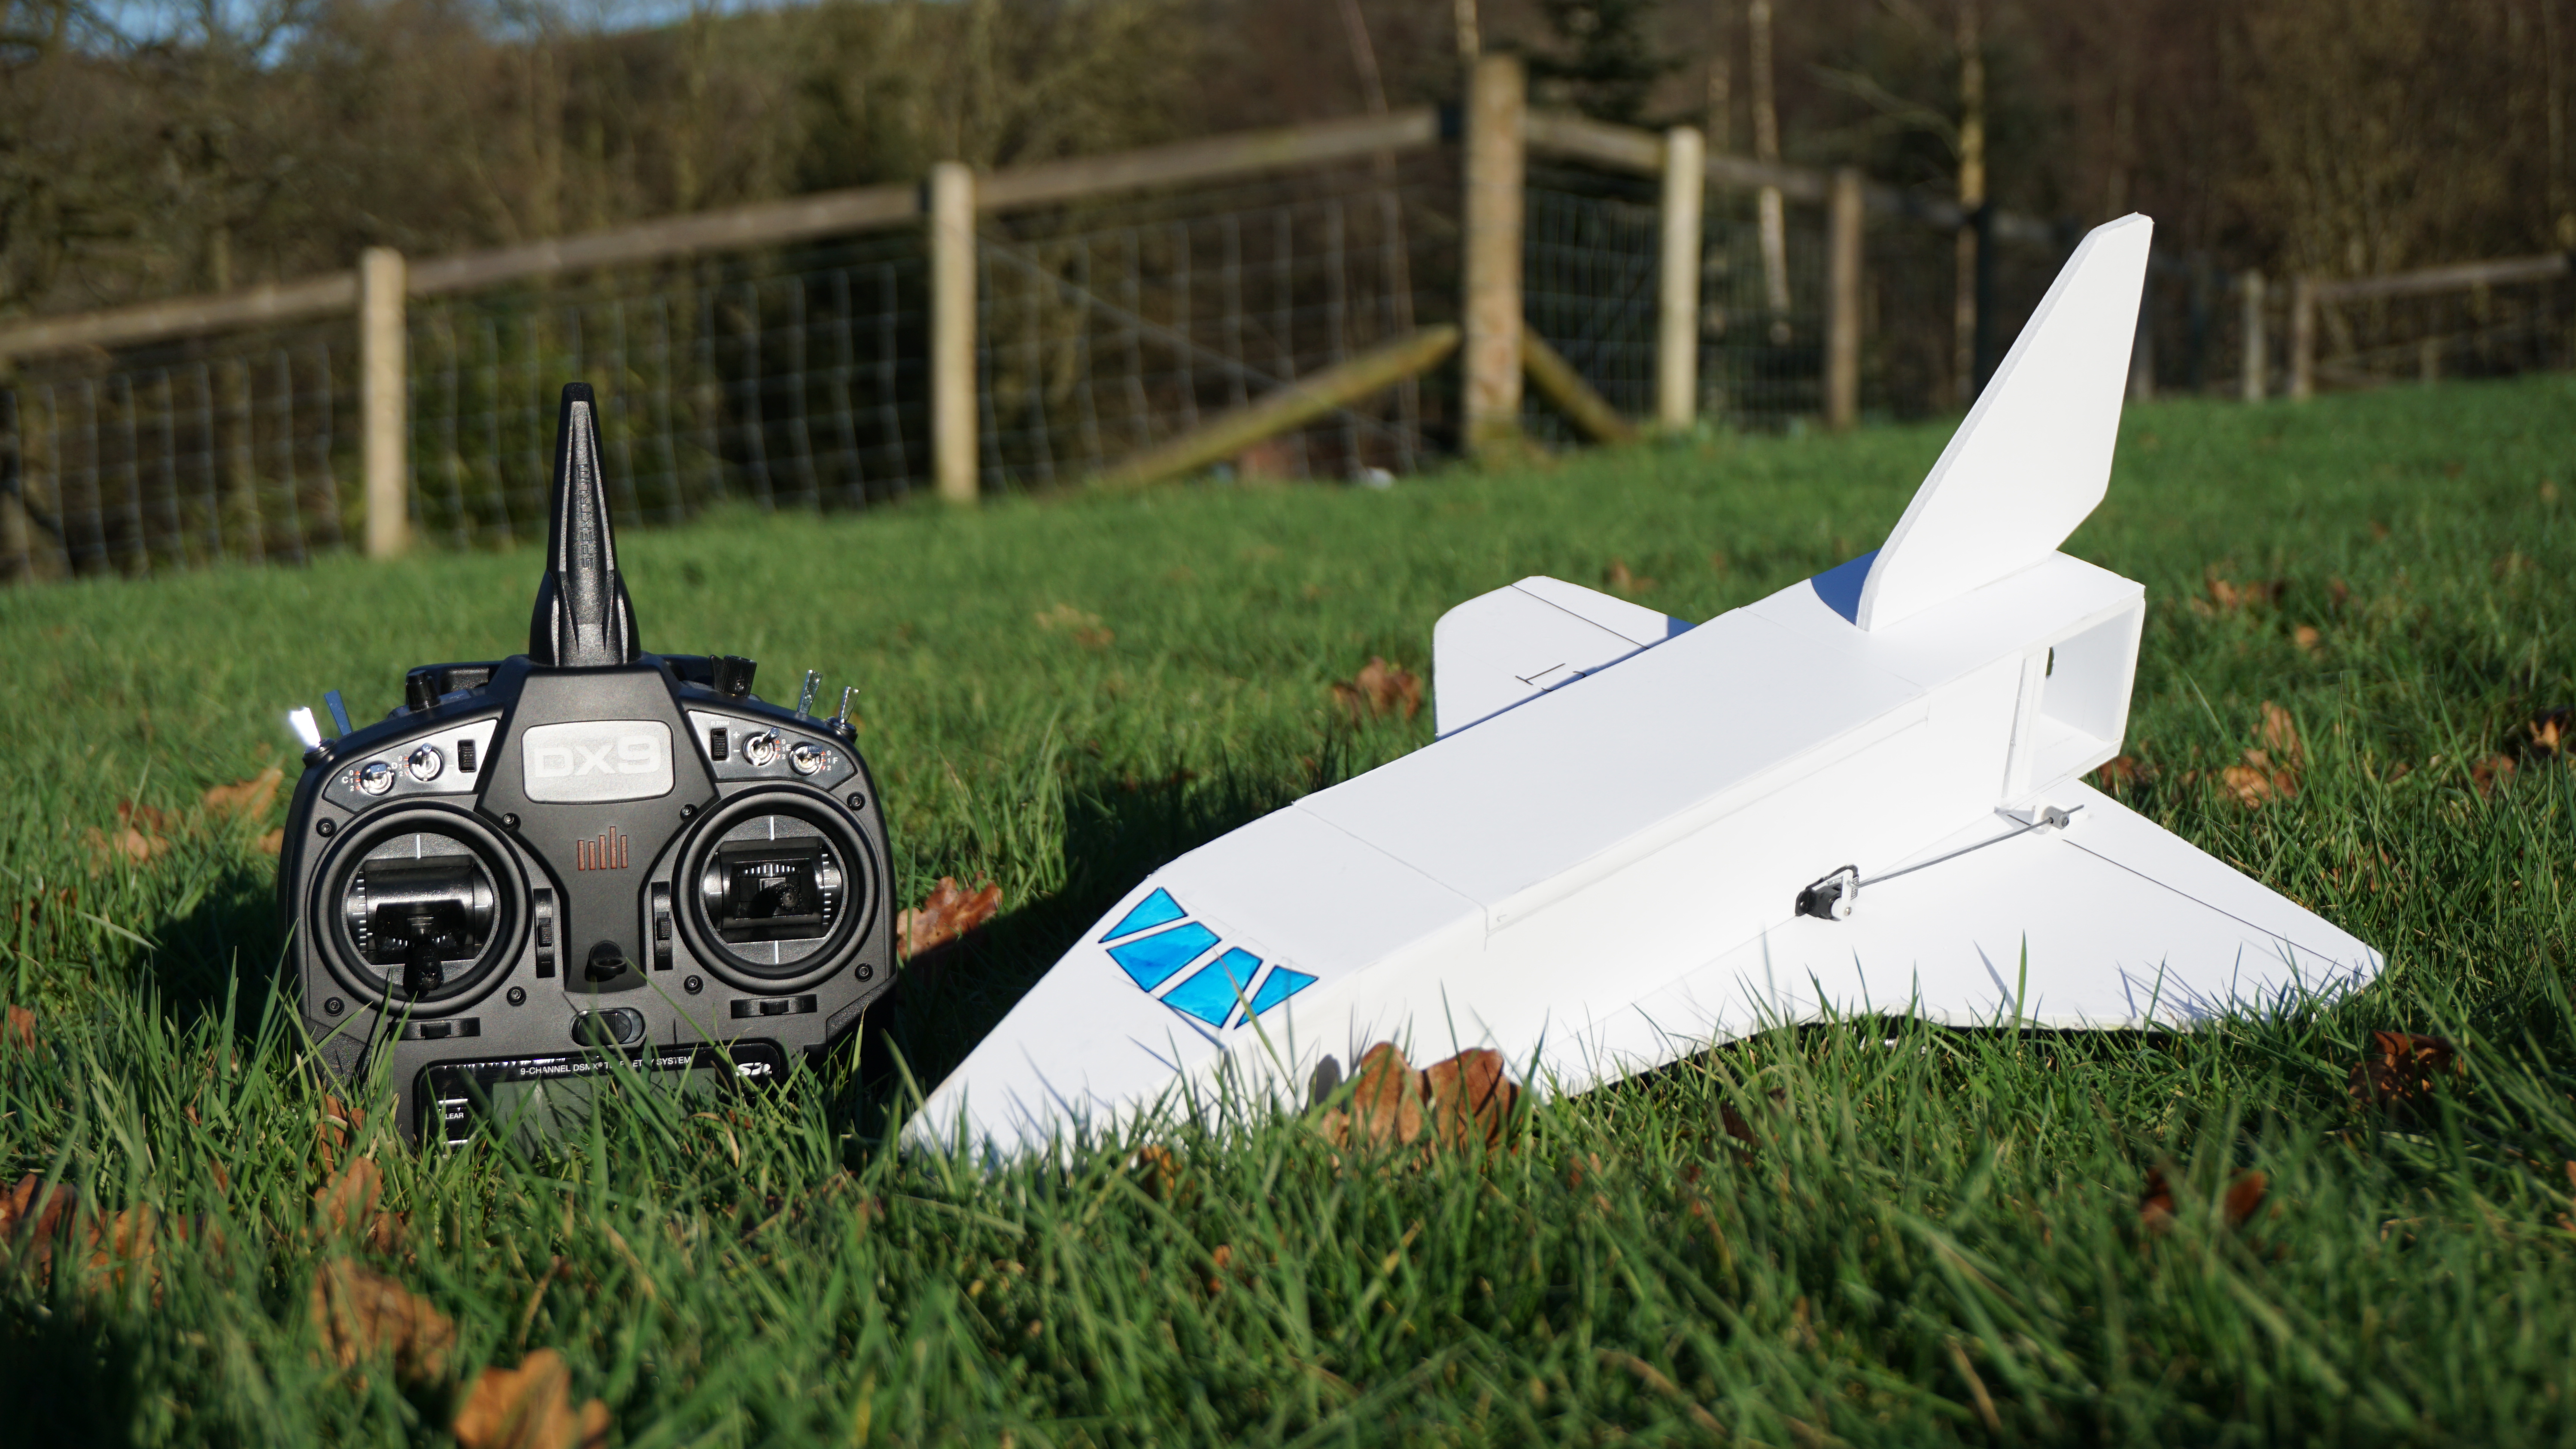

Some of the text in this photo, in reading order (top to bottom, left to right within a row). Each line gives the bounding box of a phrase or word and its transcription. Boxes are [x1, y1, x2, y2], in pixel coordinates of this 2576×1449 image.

[577, 464, 594, 570] SPEKTRUM
[535, 735, 661, 778] DX9
[520, 1064, 571, 1075] 9-CHANNEL
[656, 1056, 692, 1066] SYSTEM
